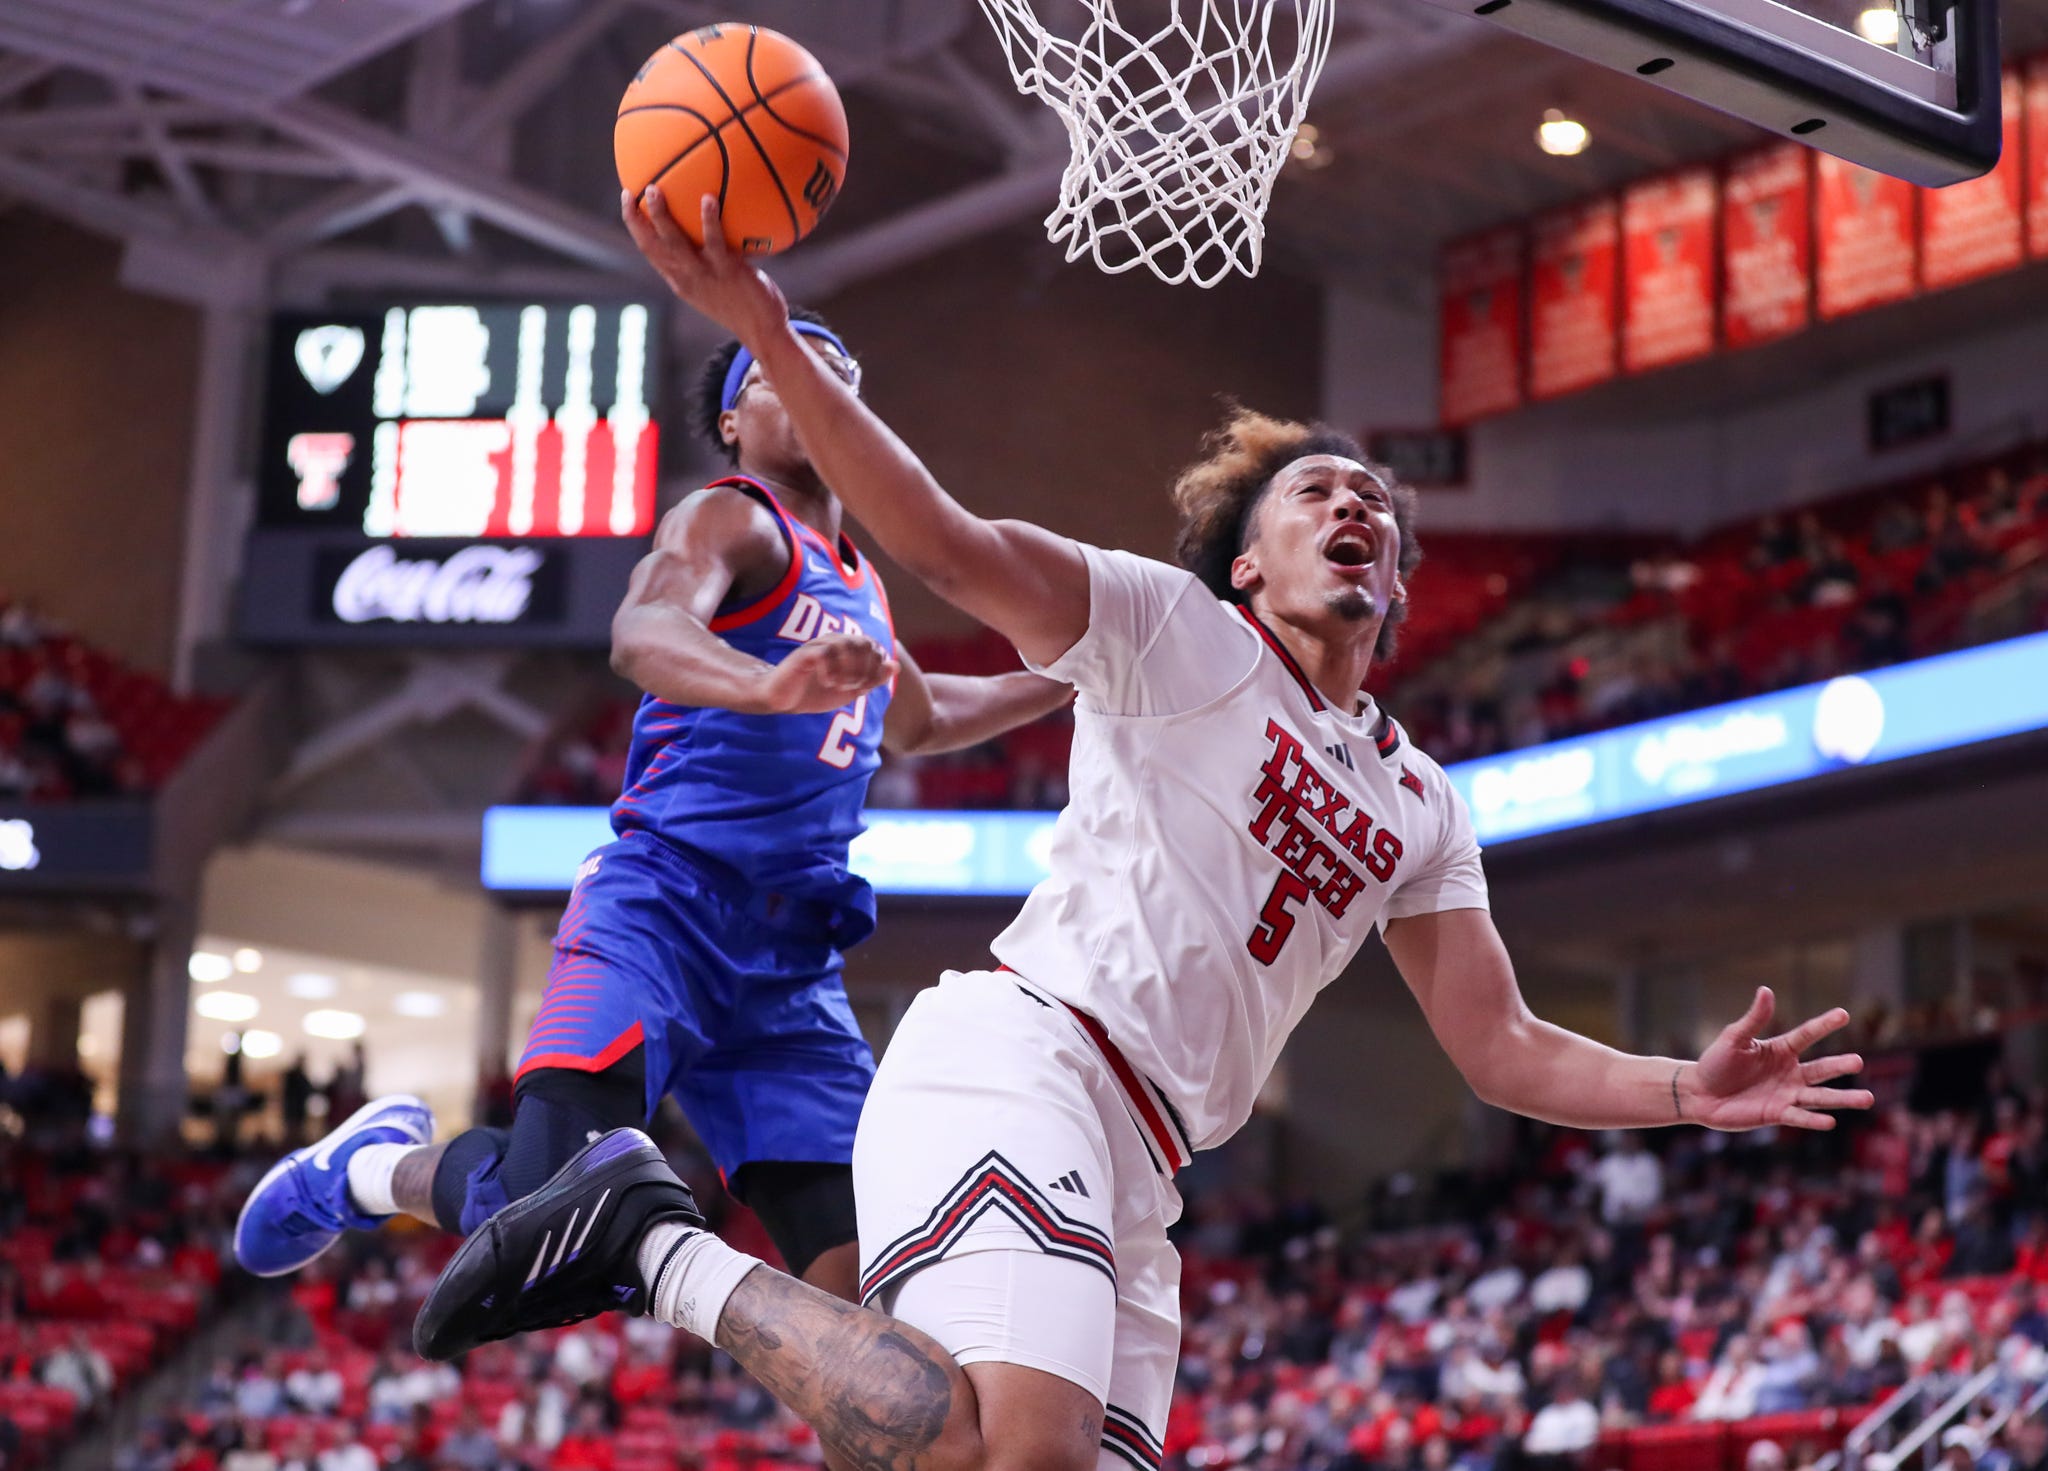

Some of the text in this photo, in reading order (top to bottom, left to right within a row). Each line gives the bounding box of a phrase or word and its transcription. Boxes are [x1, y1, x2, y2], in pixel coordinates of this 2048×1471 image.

[817, 694, 867, 770] 2
[1248, 775, 1366, 920] TECH
[1261, 717, 1403, 883] TEXAS
[1247, 867, 1310, 967] 5
